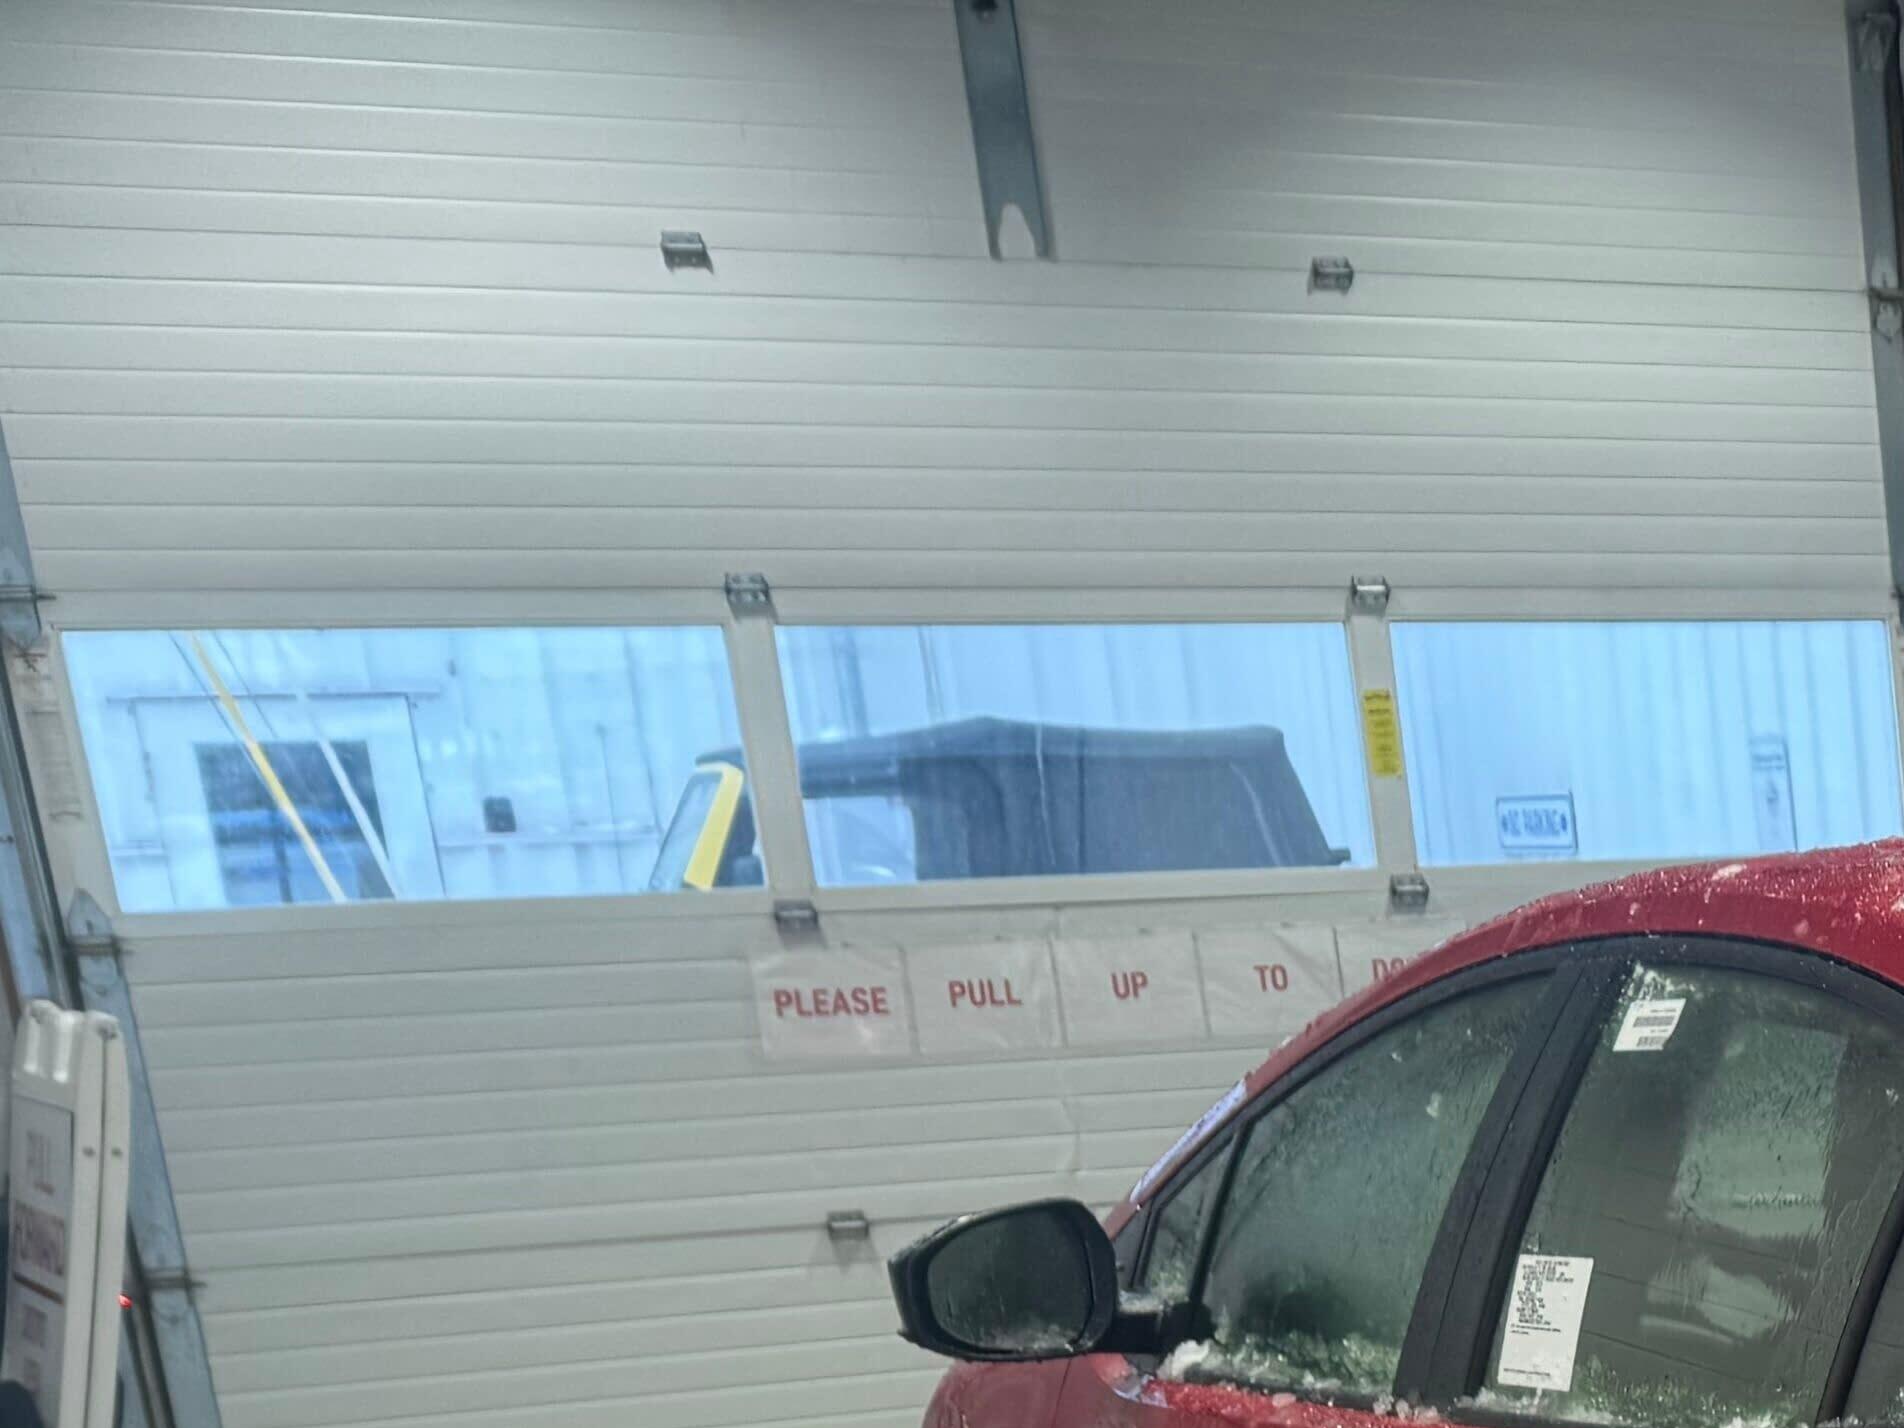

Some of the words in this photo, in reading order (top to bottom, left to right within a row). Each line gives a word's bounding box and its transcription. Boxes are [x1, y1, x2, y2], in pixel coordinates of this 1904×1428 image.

[773, 986, 890, 1018] PLEASE
[949, 976, 1022, 1008] PULL
[1111, 971, 1148, 1000] UP
[1253, 964, 1289, 993] TO
